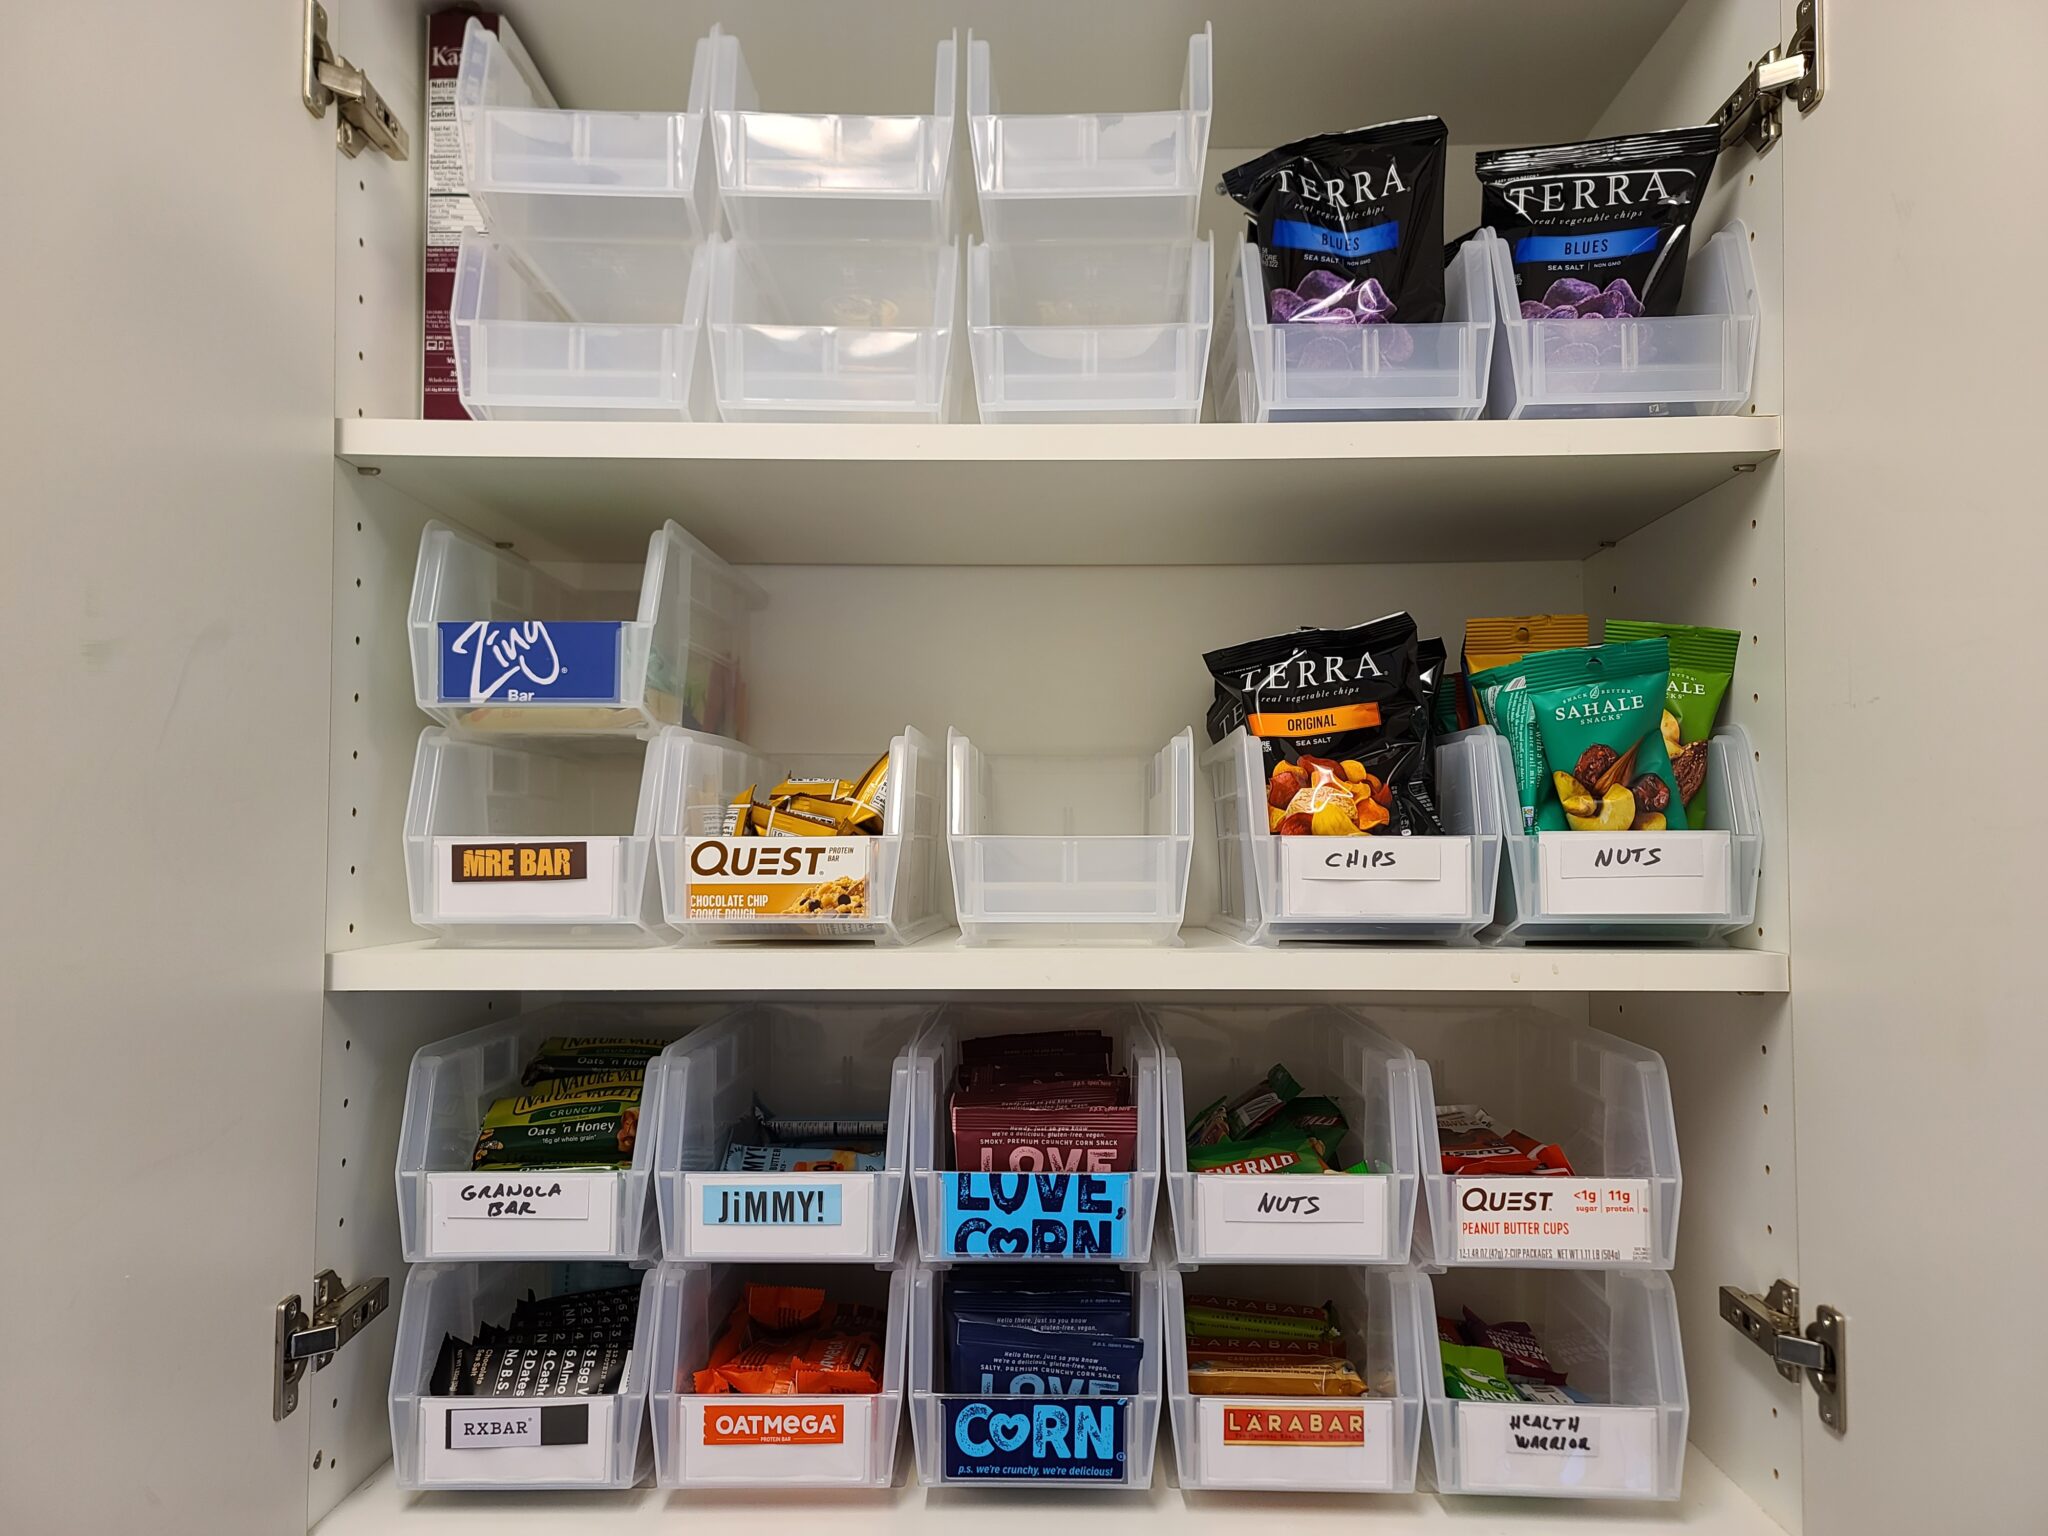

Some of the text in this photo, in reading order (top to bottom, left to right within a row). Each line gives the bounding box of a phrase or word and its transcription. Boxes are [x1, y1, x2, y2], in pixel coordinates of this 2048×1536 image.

[1271, 163, 1407, 208] TERRA
[1509, 170, 1671, 215] TERRA
[1294, 203, 1313, 213] real
[1362, 206, 1385, 217] chips
[1534, 209, 1644, 227] real vegetable chips
[1321, 233, 1360, 251] BLUES
[1564, 238, 1609, 255] BLUES
[1303, 254, 1319, 262] SEA
[1320, 256, 1339, 264] SALT
[1239, 651, 1383, 692] TERRA
[508, 689, 534, 702] Bar
[1261, 686, 1360, 704] real vegetable chips
[1666, 680, 1706, 695] ALE
[1562, 693, 1588, 704] SNACK
[1555, 695, 1644, 721] SAHALE
[1287, 713, 1337, 731] ORIGINAL
[1580, 714, 1621, 725] SNACKS
[1295, 736, 1331, 747] SEA SALT
[463, 848, 571, 877] MRE BAR
[690, 840, 827, 876] QUEST
[1325, 849, 1396, 868] CHIPS
[1594, 847, 1662, 867] NUTS
[690, 895, 768, 907] CHOCOLATE CHIP
[690, 908, 756, 919] COOKIE DOUGH
[577, 1056, 604, 1065] Oats
[624, 1058, 647, 1066] Hon
[557, 1071, 614, 1094] NATURE
[549, 1105, 604, 1118] CRUNCHY
[528, 1127, 556, 1137] Oats
[575, 1121, 616, 1133] Honey
[460, 1183, 562, 1201] GRANOLA
[1462, 1187, 1553, 1212] QUEST
[1573, 1189, 1597, 1204] <1g
[1608, 1189, 1631, 1204] 11g
[487, 1200, 536, 1217] BAR
[718, 1190, 824, 1223] JiMMY!
[1257, 1192, 1320, 1215] NUTS
[1605, 1204, 1635, 1213] protein
[1462, 1221, 1570, 1235] PEANUT BUTTER CUPS
[1522, 1249, 1553, 1259] PACKAGES
[1557, 1249, 1568, 1259] NET
[1569, 1249, 1579, 1259] WT
[1592, 1250, 1600, 1260] LB
[470, 1349, 485, 1377] Sea Salt
[1043, 1353, 1057, 1361] just
[476, 1349, 493, 1385] Chocolate
[495, 1349, 518, 1395] No B.S.
[516, 1349, 538, 1397] 2 Dates
[536, 1349, 557, 1396] 4 Cash
[557, 1349, 577, 1395] 6 Almo
[579, 1349, 597, 1384] 3 Egg
[1041, 1367, 1074, 1376] CRUNCHY
[1459, 1381, 1520, 1401] HEALTH
[463, 1421, 529, 1436] RXBAR
[955, 1402, 1115, 1459] CORN
[1509, 1414, 1580, 1433] HEALTH
[1514, 1434, 1591, 1451] WARRIOR
[958, 1464, 1113, 1477] p.s. we're crunchy, we're delicious!
